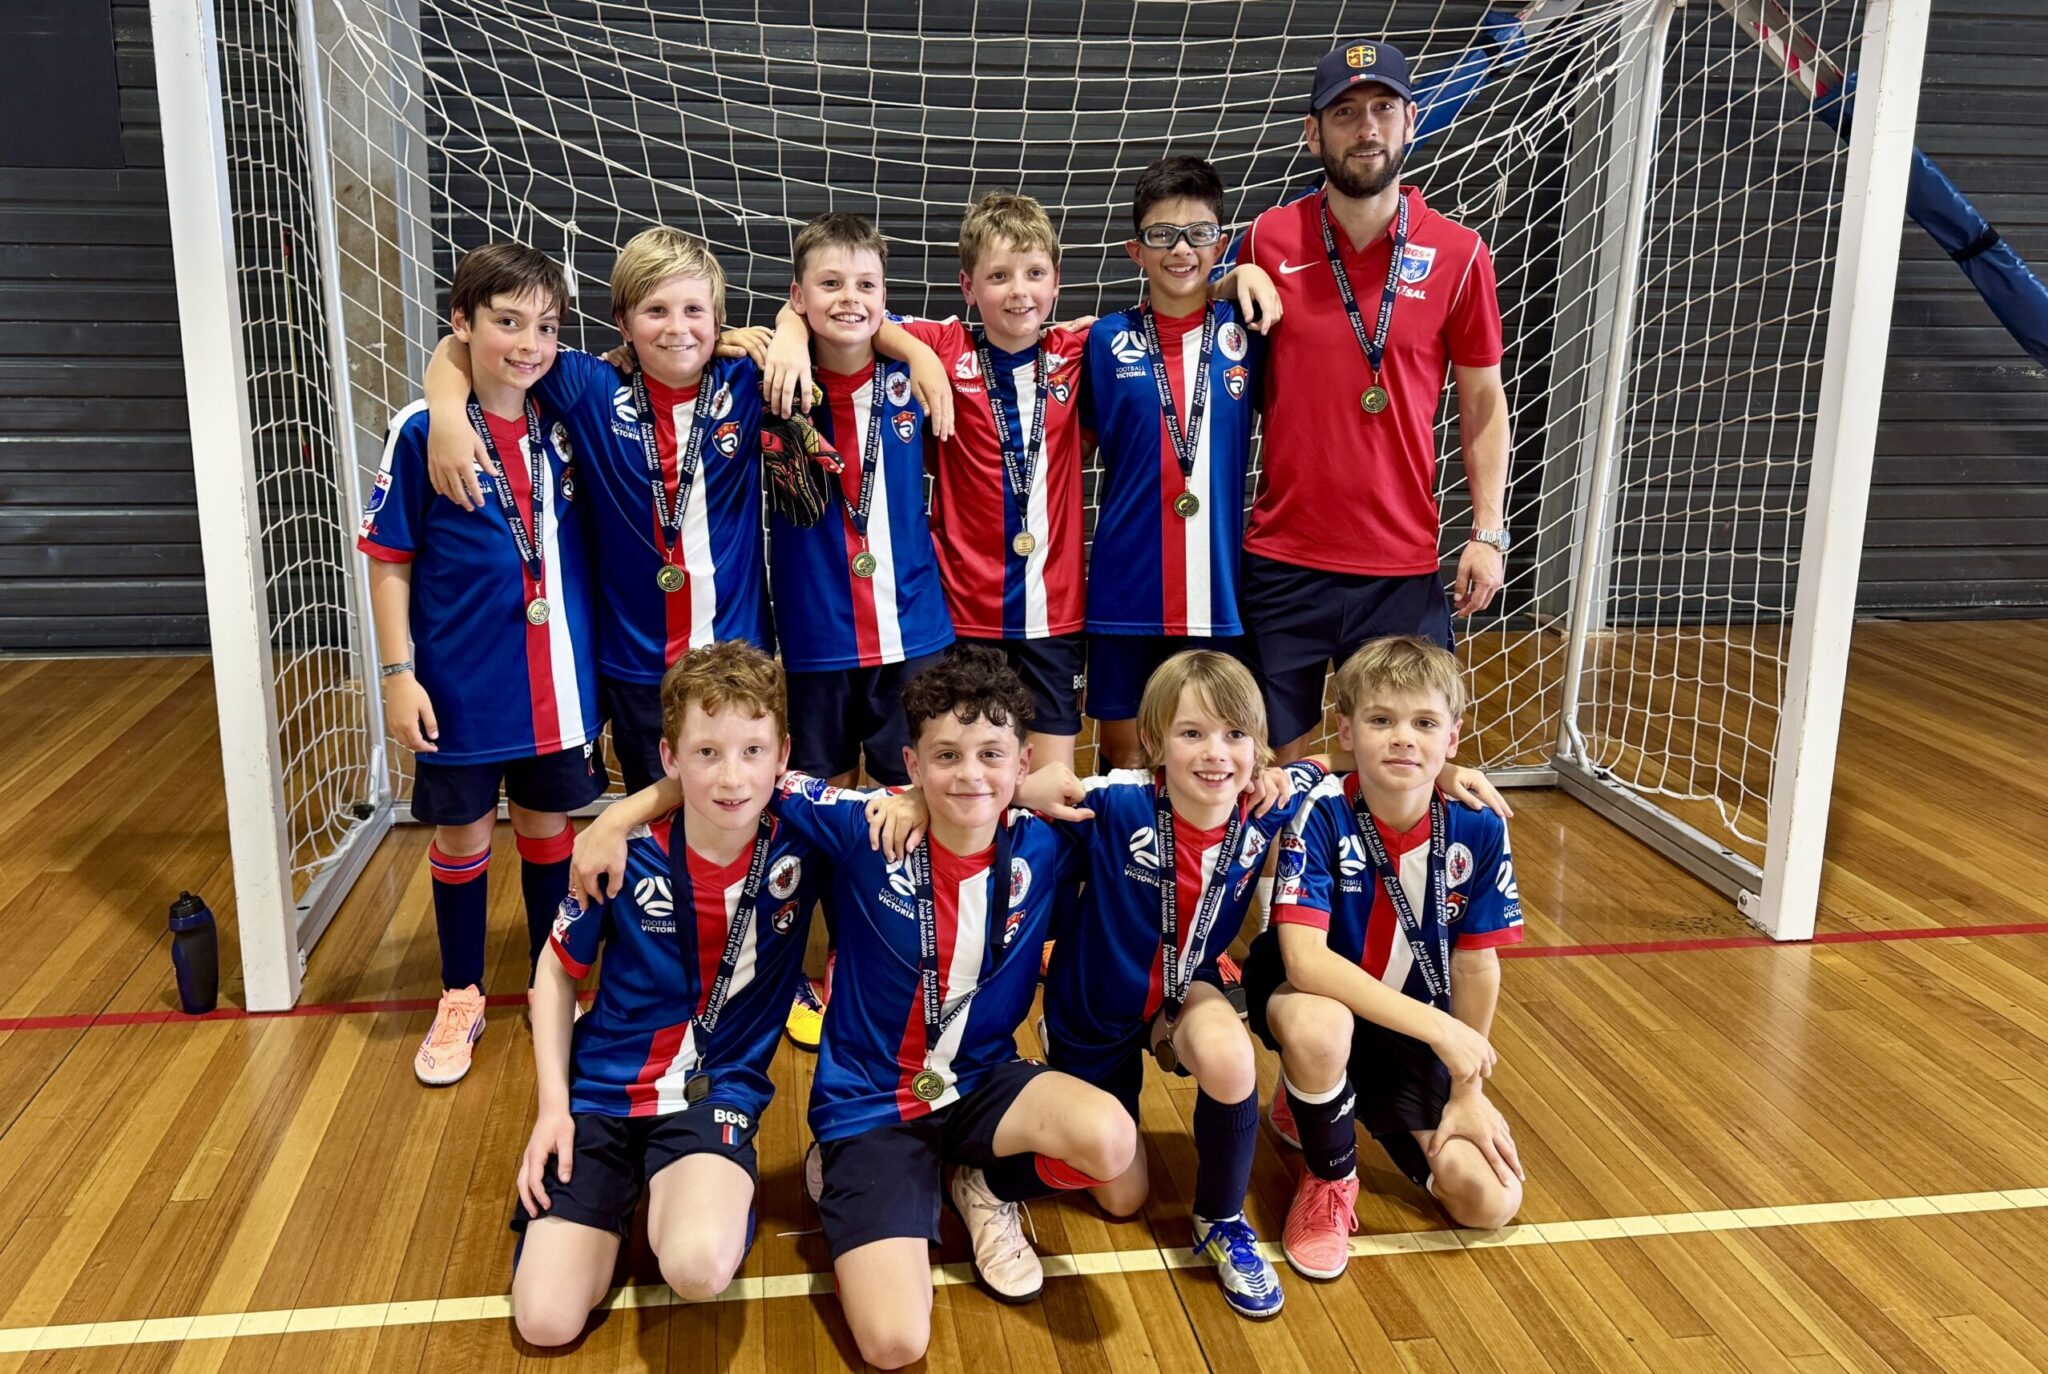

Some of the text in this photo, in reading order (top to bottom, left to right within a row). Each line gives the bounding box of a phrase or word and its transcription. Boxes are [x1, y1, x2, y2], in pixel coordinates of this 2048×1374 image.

[1116, 366, 1145, 374] FOOTBALL
[1116, 371, 1146, 379] VICTORIA
[362, 520, 378, 536] SAL
[1124, 869, 1160, 888] VICTORIA
[878, 894, 914, 920] VICTORIA
[881, 888, 916, 912] FOOTBALL
[1504, 902, 1520, 912] FOOT
[641, 925, 677, 933] VICTORI
[920, 920, 928, 958] Association
[924, 988, 932, 1024] Association
[714, 1108, 748, 1128] BGS
